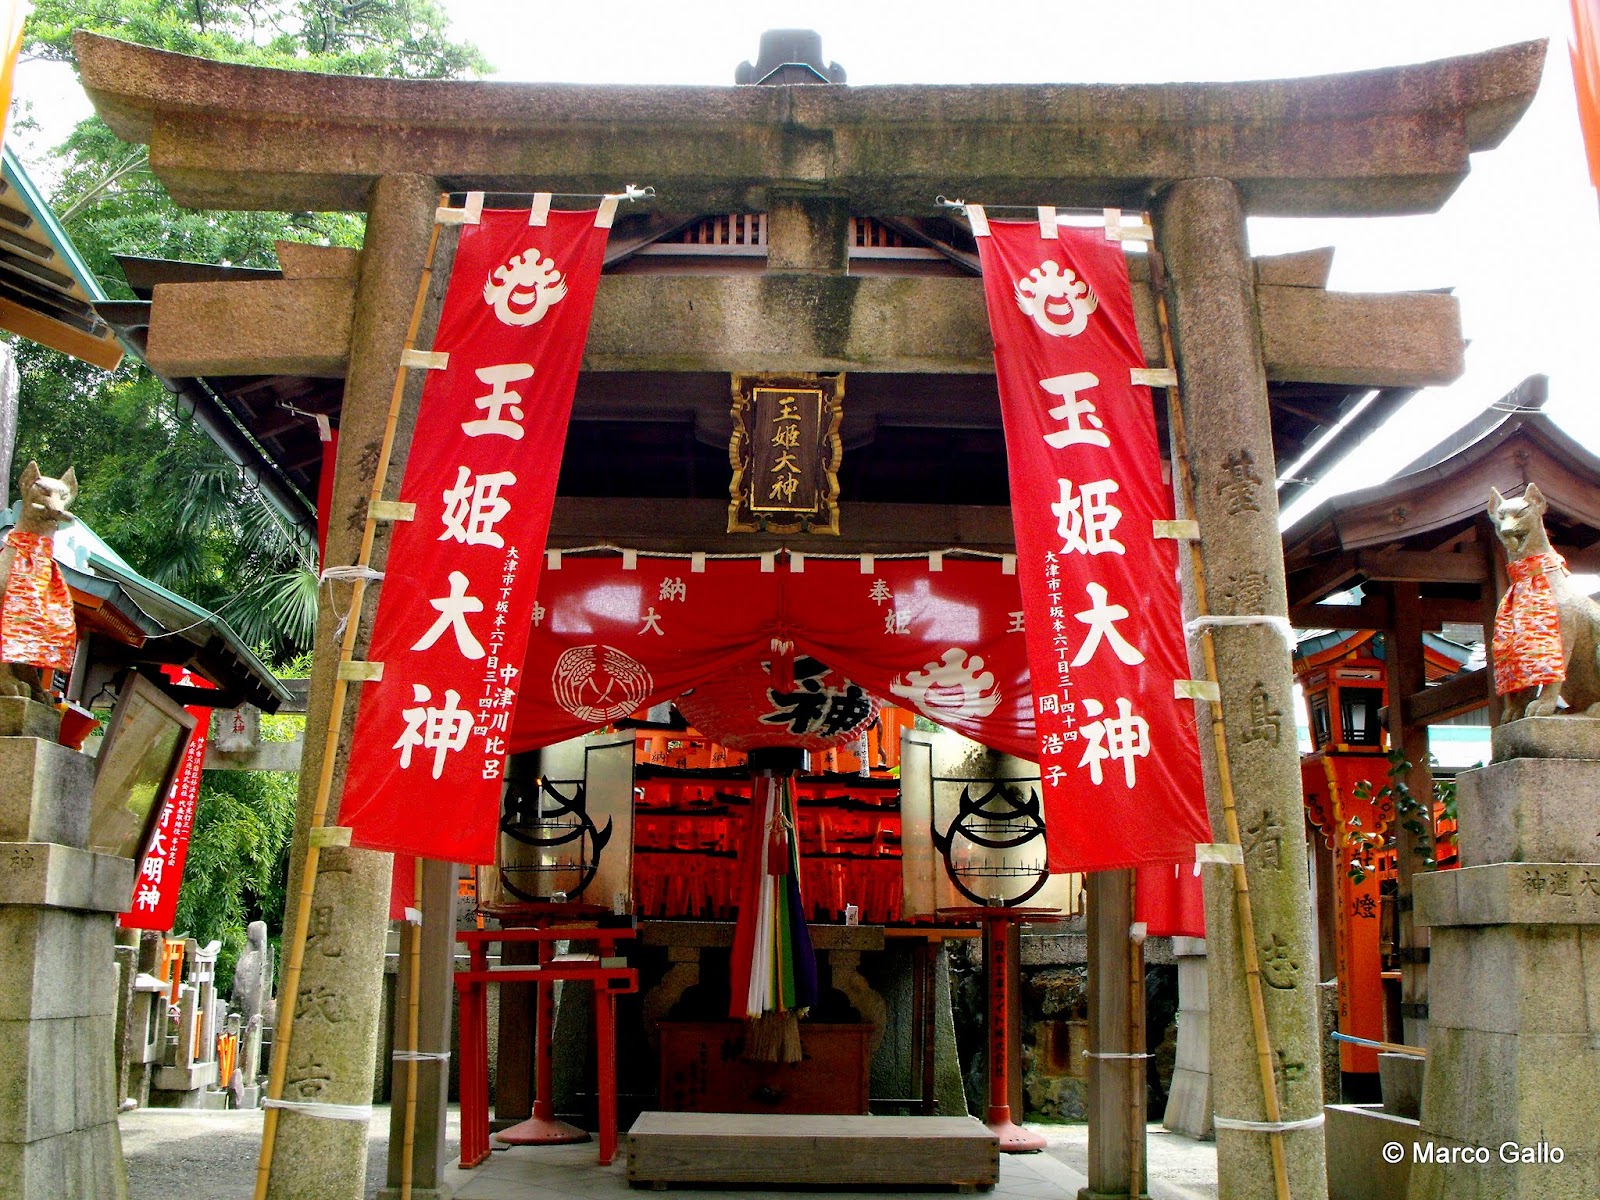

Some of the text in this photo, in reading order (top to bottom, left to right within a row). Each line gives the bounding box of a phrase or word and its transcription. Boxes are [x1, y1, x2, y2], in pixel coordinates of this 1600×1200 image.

[768, 396, 802, 504] 玉姫大神
[391, 362, 535, 781] 玉姫大神
[637, 606, 665, 637] 大
[658, 576, 893, 606] 奉 納
[1038, 371, 1151, 790] 玉姫大神
[481, 662, 519, 780] 中津川比呂
[1038, 693, 1068, 788] 岡浩子
